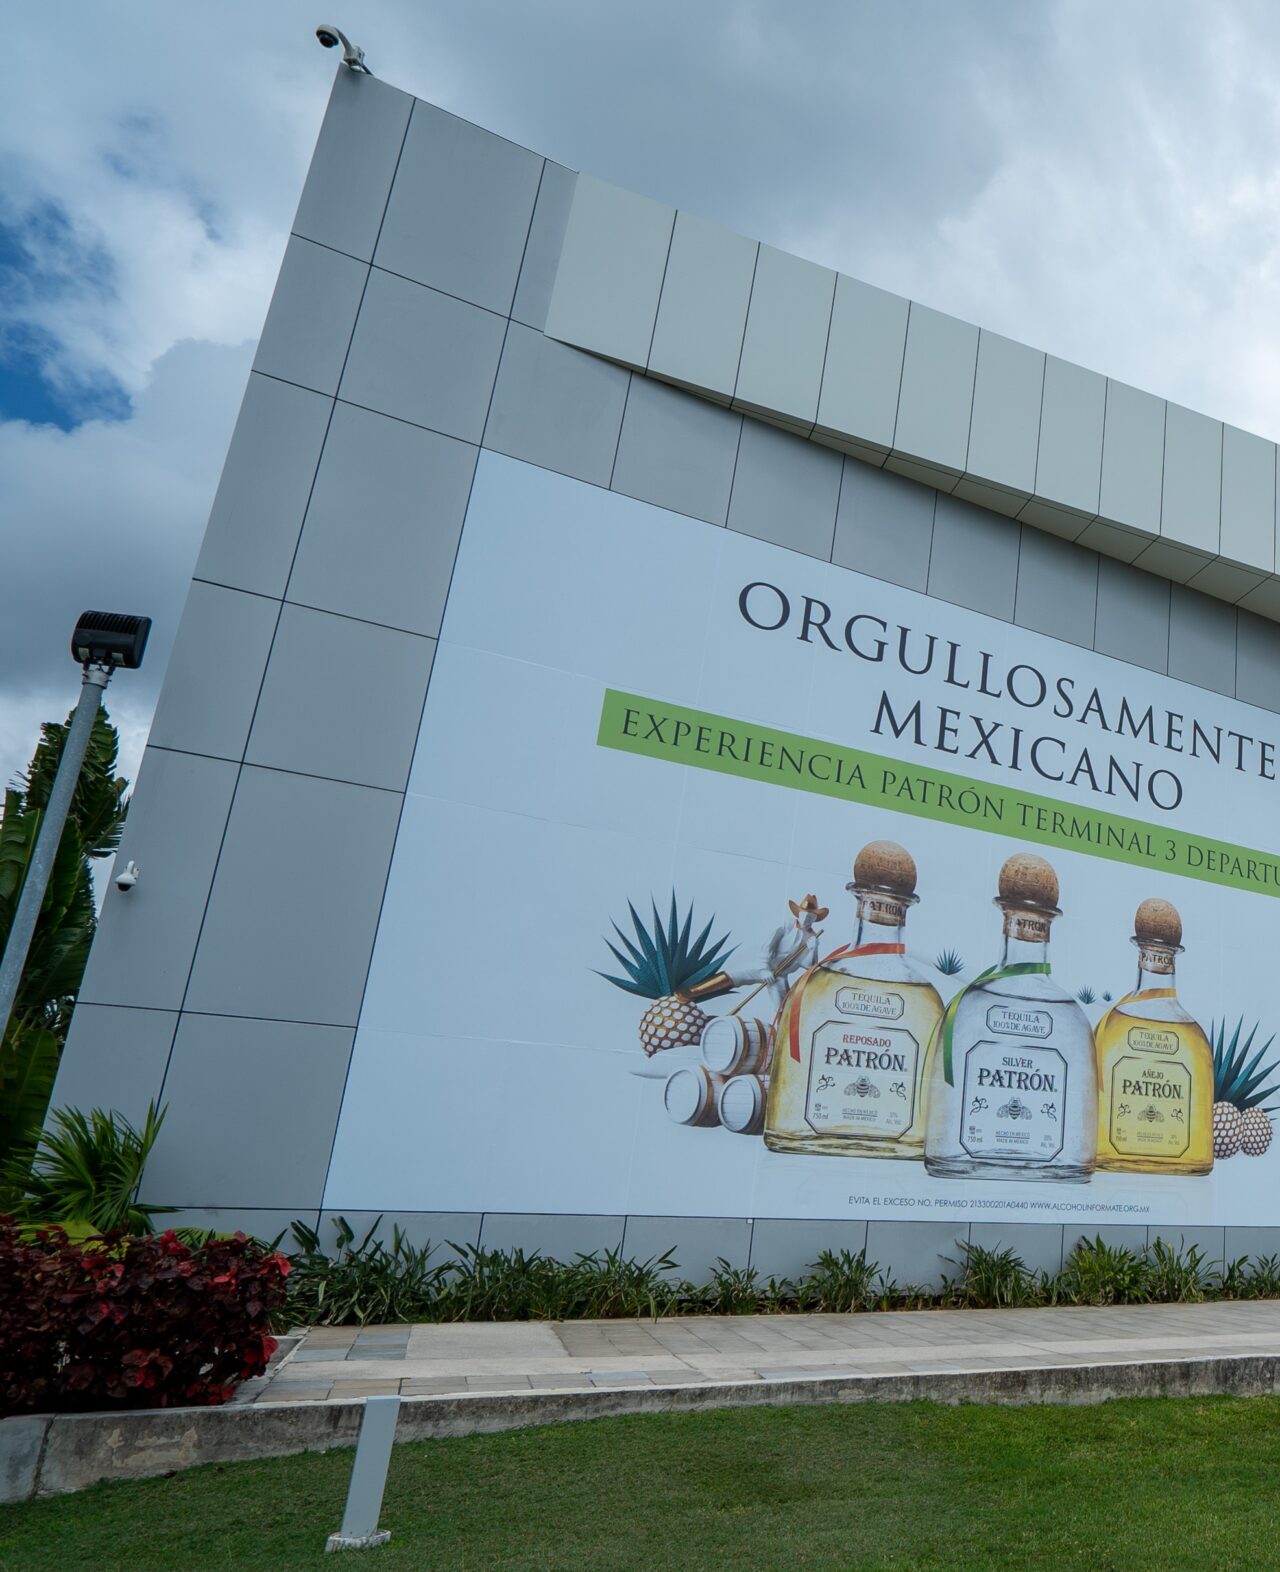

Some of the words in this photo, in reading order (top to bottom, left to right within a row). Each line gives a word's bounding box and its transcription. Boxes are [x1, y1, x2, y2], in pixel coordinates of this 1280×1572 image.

[738, 582, 1276, 780] ORGULLOSAMENTE
[870, 690, 1183, 810] MEXICANO
[621, 708, 867, 790] EXPERIENCIA
[880, 769, 1004, 820] PATRÓN
[1016, 802, 1156, 857] TERMINAL
[1165, 839, 1176, 861] 3
[851, 992, 891, 1006] TEQUILA
[1001, 1010, 1040, 1024] TEQUILA
[842, 1034, 892, 1048] REPOSADO
[1139, 1031, 1169, 1042] TEQUILA
[825, 1047, 906, 1072] PATRÓN
[1001, 1056, 1033, 1069] SILVER
[977, 1068, 1056, 1092] PATRÓN
[1141, 1069, 1164, 1080] AÑEJO
[1122, 1079, 1182, 1099] PATRÓN
[848, 1196, 870, 1205] EVITA
[873, 1197, 882, 1205] EL
[884, 1197, 916, 1207] EXCESO
[917, 1198, 933, 1207] NO.
[935, 1199, 968, 1208] PERMISO
